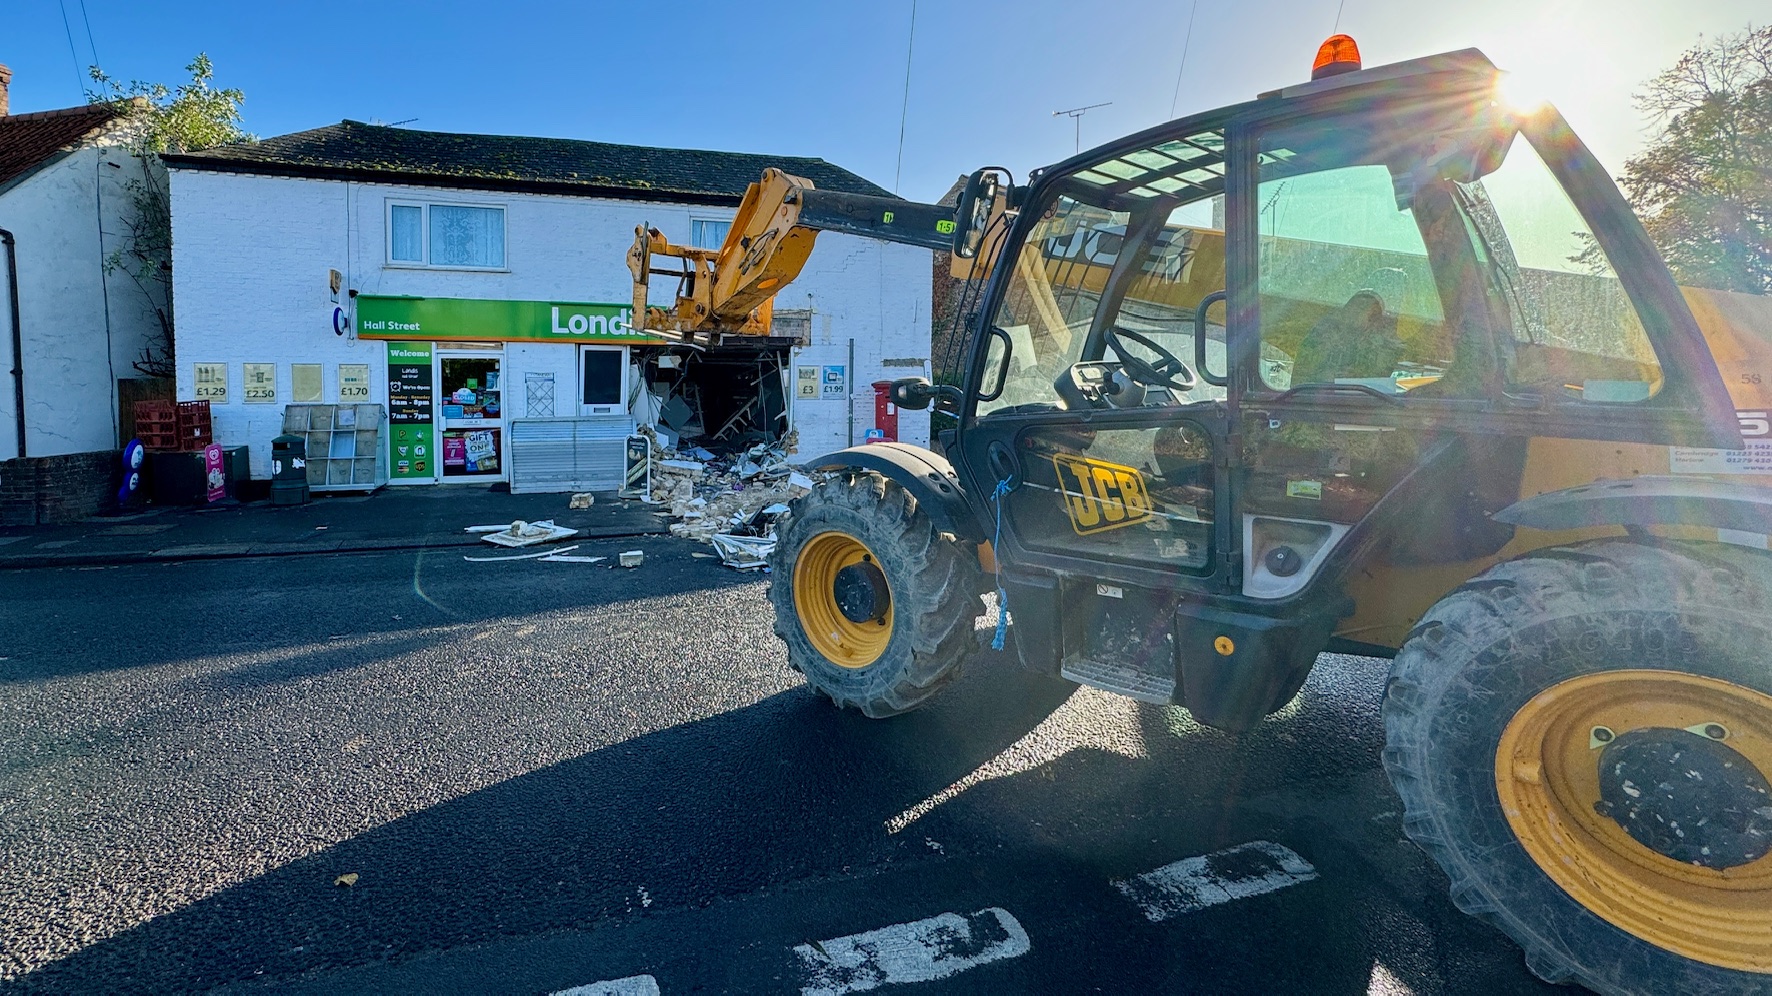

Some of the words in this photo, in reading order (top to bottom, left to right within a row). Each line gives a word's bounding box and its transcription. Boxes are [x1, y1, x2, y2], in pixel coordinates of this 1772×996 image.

[363, 320, 385, 330] Hall
[388, 320, 421, 331] Street
[551, 306, 647, 337] Londi
[389, 349, 430, 358] Welcome
[196, 387, 226, 397] £1.29
[246, 388, 275, 399] £2.50
[340, 387, 368, 397] £1.70
[802, 385, 814, 395] £3
[823, 385, 844, 394] £1.99
[413, 412, 430, 420] 7pm
[469, 433, 489, 442] GIFT
[1069, 462, 1145, 527] JCB
